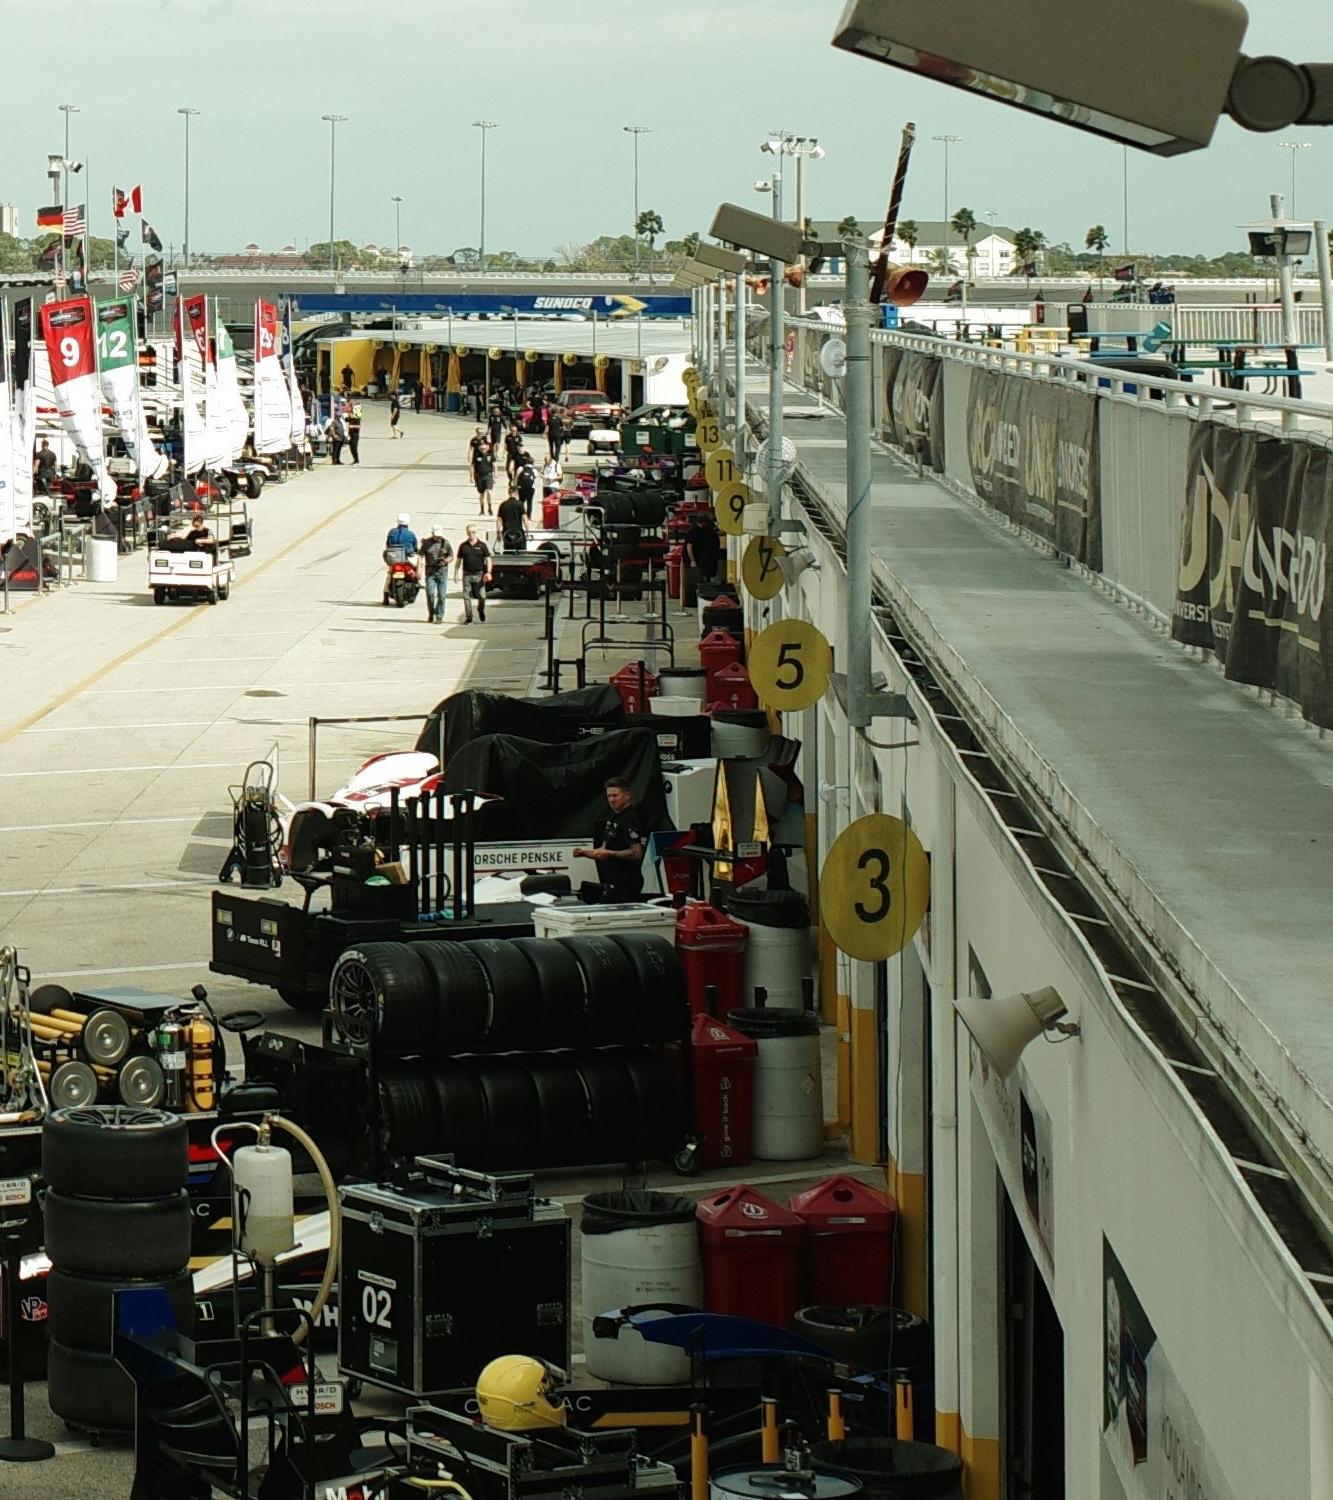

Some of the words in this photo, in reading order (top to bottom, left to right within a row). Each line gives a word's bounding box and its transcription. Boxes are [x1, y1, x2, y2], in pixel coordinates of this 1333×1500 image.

[534, 296, 593, 310] SUNOCO
[60, 337, 80, 367] 9
[97, 331, 128, 359] 12
[701, 425, 719, 443] 13
[717, 459, 733, 481] 11
[729, 494, 745, 523] 9
[776, 643, 804, 690] 5
[521, 851, 563, 863] PENSKE
[855, 848, 891, 924] 3
[361, 1285, 393, 1329] 02
[314, 1402, 336, 1410] OSCH
